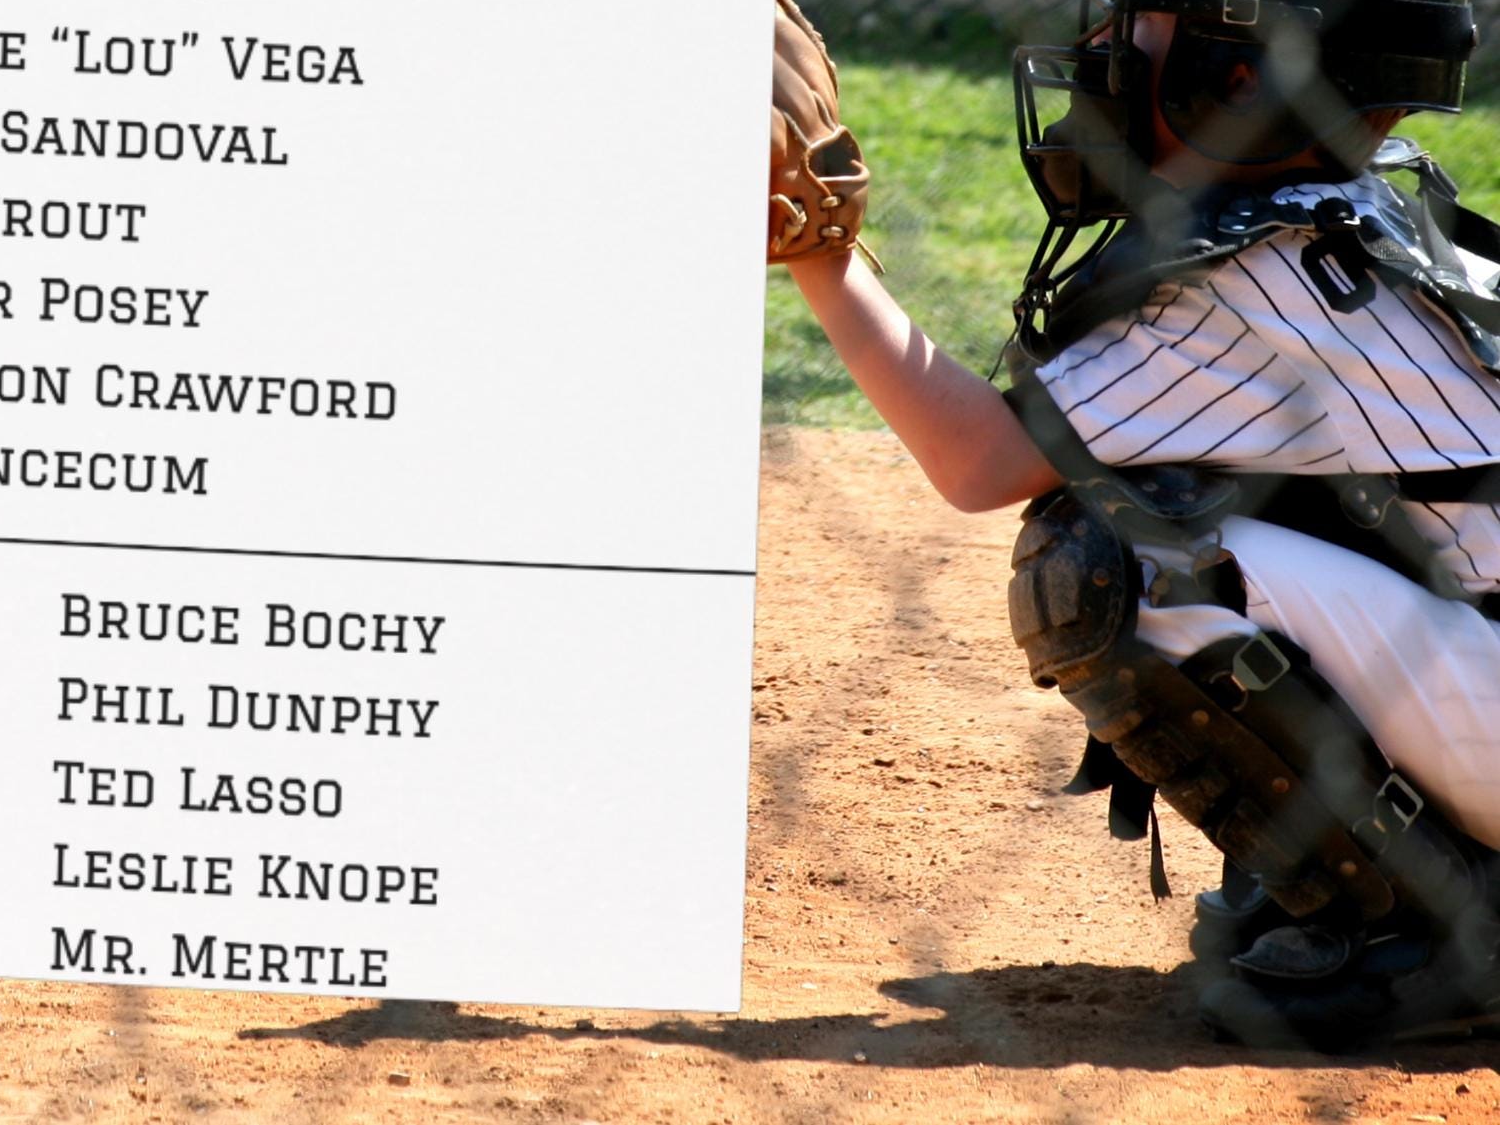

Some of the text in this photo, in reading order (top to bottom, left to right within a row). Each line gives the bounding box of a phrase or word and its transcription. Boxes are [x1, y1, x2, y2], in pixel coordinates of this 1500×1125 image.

[221, 36, 364, 86] VEGA
[1, 110, 288, 166] SANDOVAL
[39, 277, 209, 328] POSEY
[95, 364, 396, 421] CRAWFORD
[59, 593, 239, 645] BRUCE
[264, 603, 446, 655] BOCHY
[57, 677, 184, 727] PHIL
[207, 684, 440, 738] DUNPHY
[53, 760, 154, 808] TED
[179, 767, 342, 818] LASSO
[53, 843, 233, 896] LESLIE
[258, 854, 439, 906] KNOPE
[50, 926, 148, 975] MR.
[171, 933, 389, 988] MERTLE
